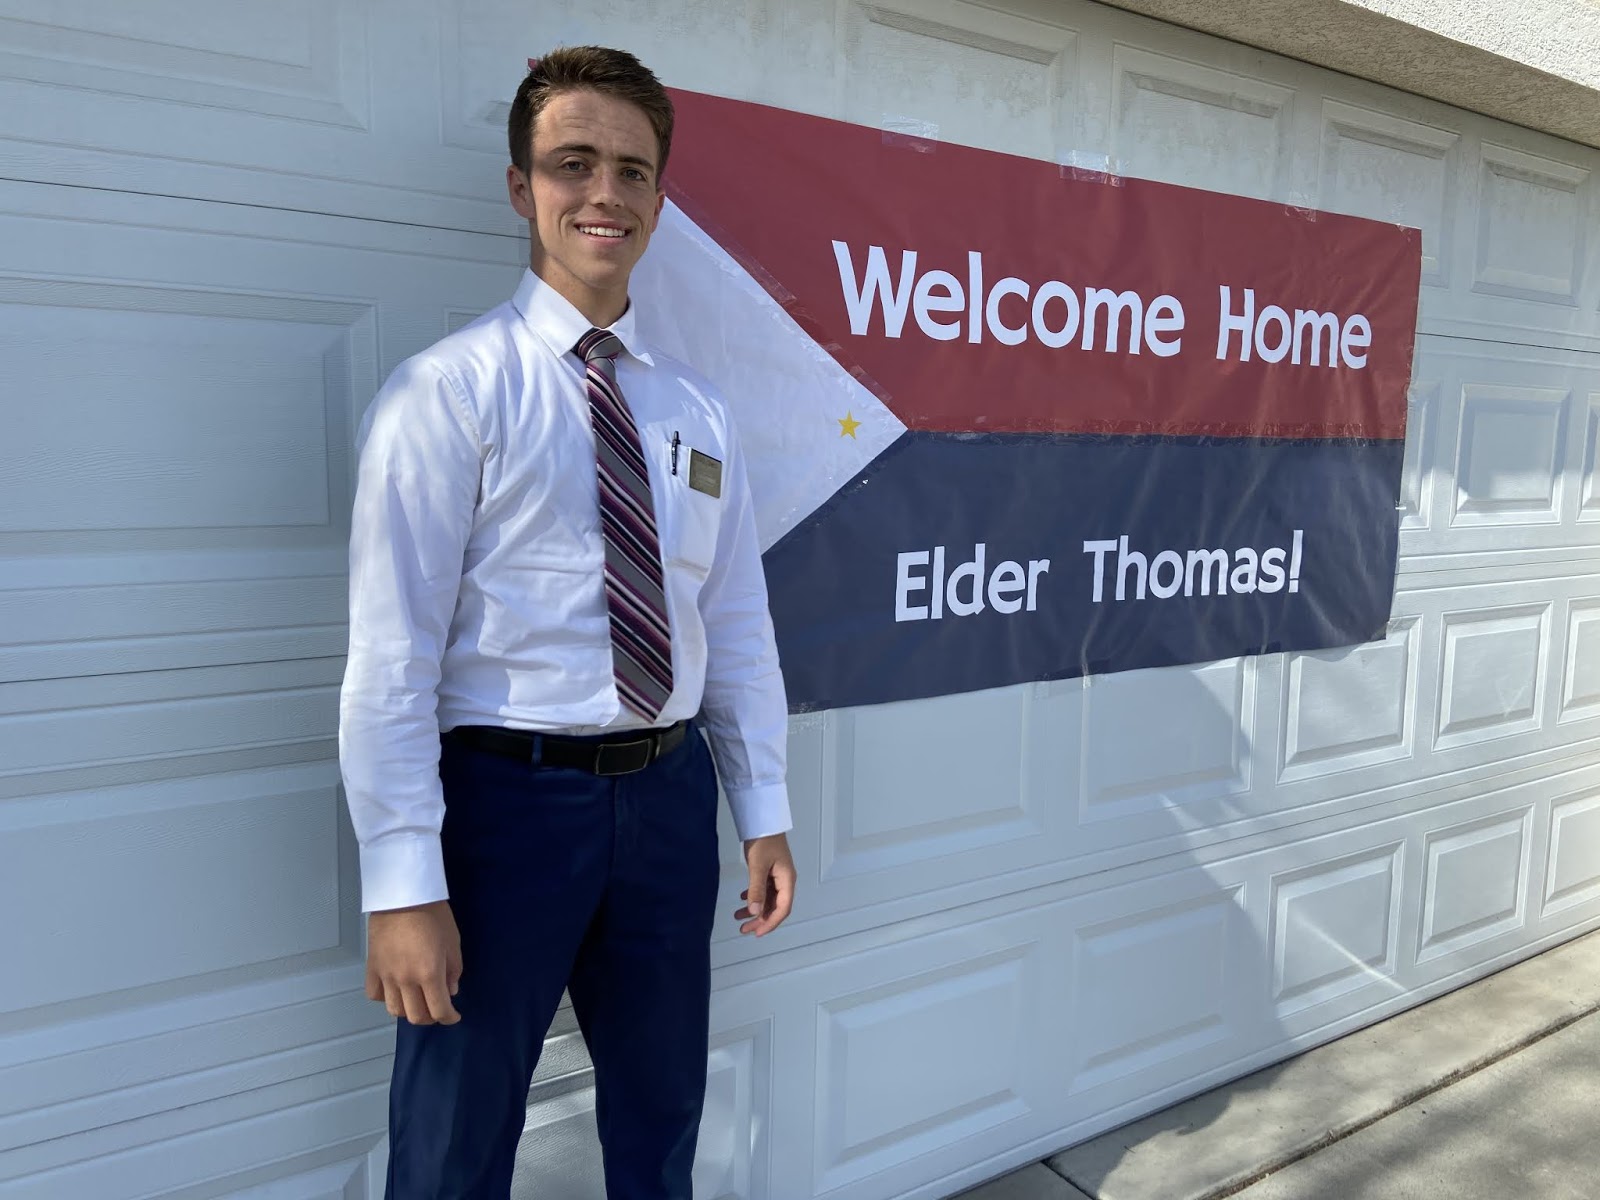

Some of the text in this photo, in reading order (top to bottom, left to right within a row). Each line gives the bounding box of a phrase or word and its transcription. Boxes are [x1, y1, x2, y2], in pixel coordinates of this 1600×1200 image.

[831, 239, 1372, 370] Welcome Home
[894, 529, 1304, 622] Elder Thomas!
